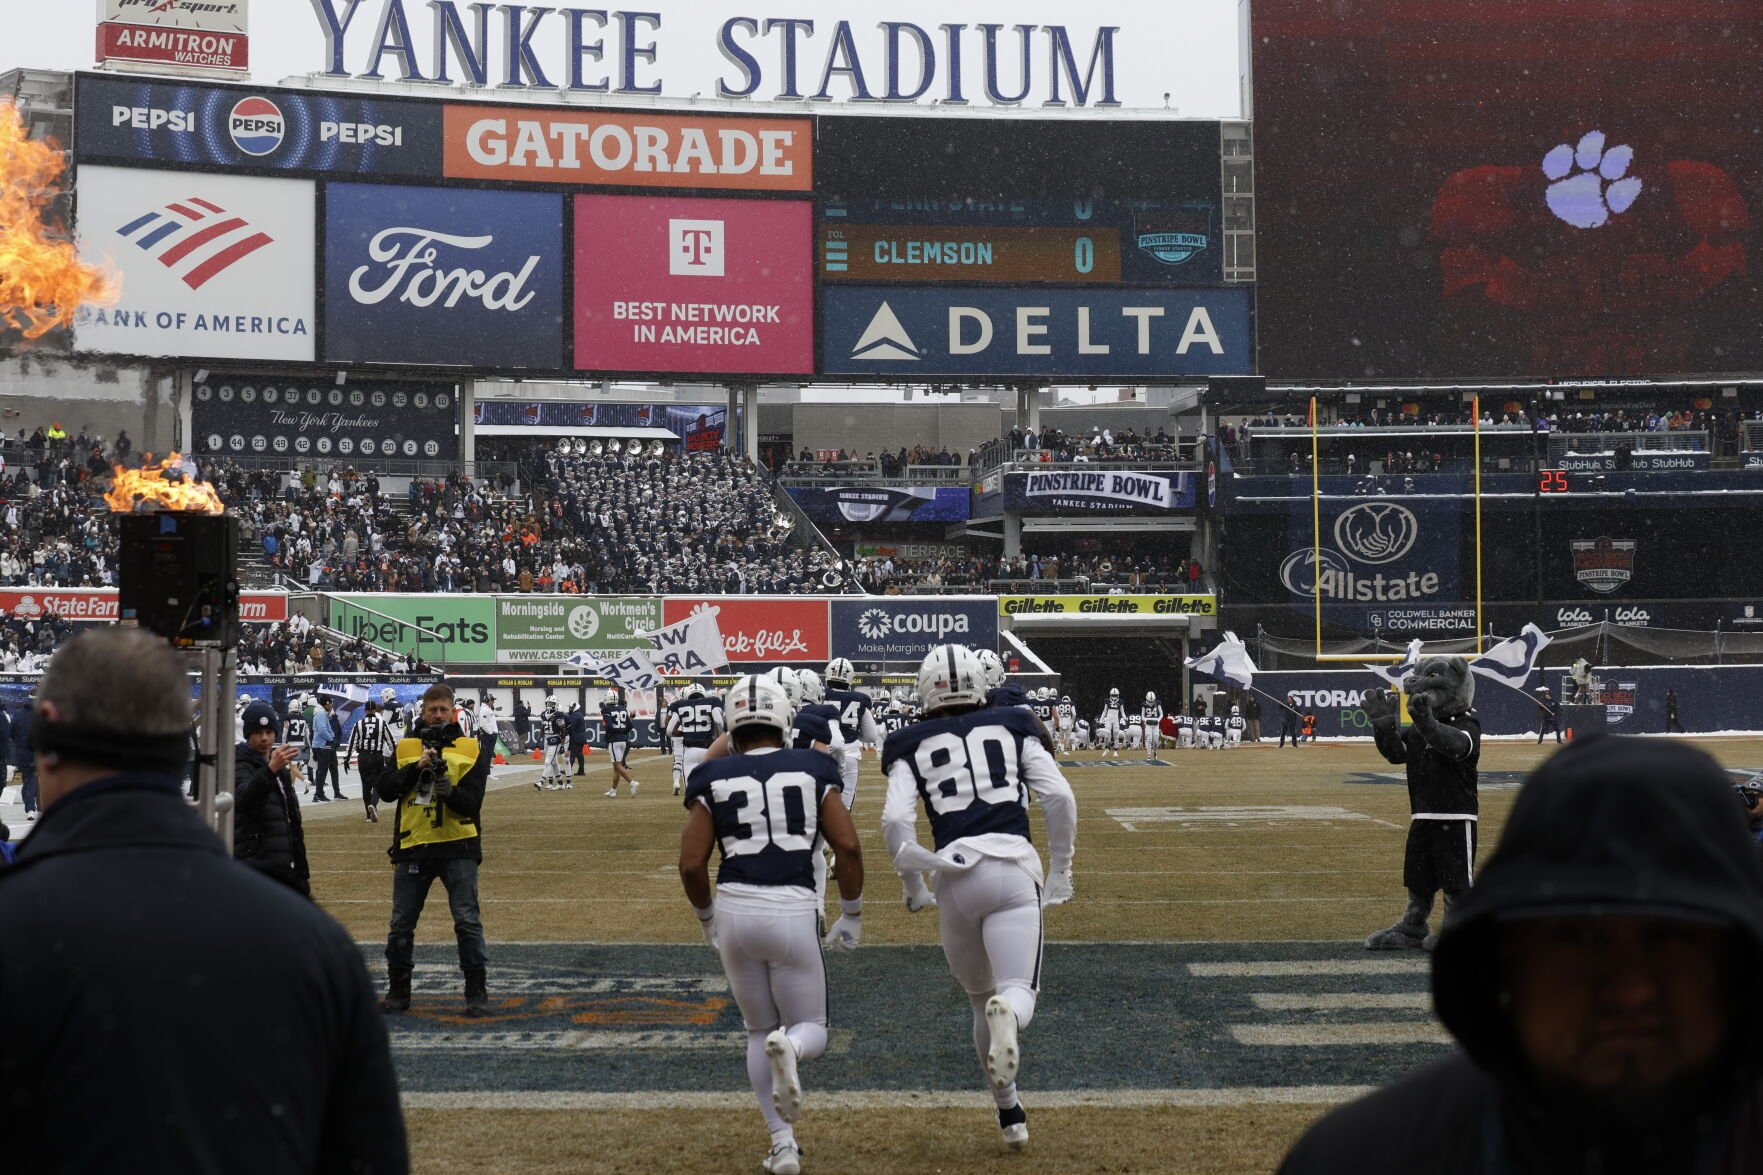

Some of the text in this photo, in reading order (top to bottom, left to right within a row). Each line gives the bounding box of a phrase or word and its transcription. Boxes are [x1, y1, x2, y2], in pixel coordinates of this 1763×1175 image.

[116, 29, 235, 54] ARMITRON
[175, 51, 232, 66] WATCHES
[310, 0, 1122, 108] YANKEE STADIUM
[111, 105, 195, 132] PEPSI
[231, 117, 282, 135] PEPSI
[320, 121, 402, 147] PEPSI
[465, 118, 793, 177] GATORADE
[827, 230, 845, 239] TOL
[1140, 235, 1205, 246] PINSTRIPE BOWL
[682, 229, 712, 266] T
[874, 237, 1094, 274] CLEMSON 0
[348, 226, 542, 312] Ford
[613, 301, 781, 324] BEST NETWORK
[156, 311, 187, 330] OF
[194, 314, 308, 335] AMERICA
[948, 306, 1225, 355] DELTA
[634, 325, 761, 345] IN AMERICA
[270, 410, 379, 433] New York Yankees
[1558, 460, 1600, 470] StubHub
[1605, 459, 1648, 469] StHub
[1652, 458, 1695, 468] StubHub
[1029, 473, 1164, 502] PINSTRIPE BOWL
[1540, 471, 1567, 491] 25
[1052, 499, 1086, 508] YANKEE
[900, 544, 966, 559] TERRACE
[1610, 570, 1630, 579] BOWL
[1310, 569, 1439, 601] Allstate
[502, 601, 565, 619] Morningside
[600, 601, 656, 616] Workmen's
[1004, 597, 1065, 614] Gillette
[1078, 597, 1139, 614] Gillette
[1152, 597, 1213, 614] Gillette
[1388, 609, 1476, 618] COLDWELL BANKER
[337, 615, 489, 644] Uber Eats
[530, 625, 553, 633] Nursing
[625, 616, 656, 630] Circle
[893, 613, 969, 639] coupa
[1388, 618, 1476, 629] COMMERCIAL
[720, 629, 808, 657] ick-fil-A
[858, 643, 884, 653] Make
[886, 643, 926, 655] Margins
[611, 710, 626, 729] 39
[678, 704, 712, 733] 25
[1129, 715, 1141, 724] 99
[1145, 708, 1158, 717] 94
[1230, 716, 1242, 727] 48
[290, 719, 306, 736] 37
[366, 723, 376, 738] F
[914, 724, 1018, 815] 80
[710, 771, 817, 859] 30
